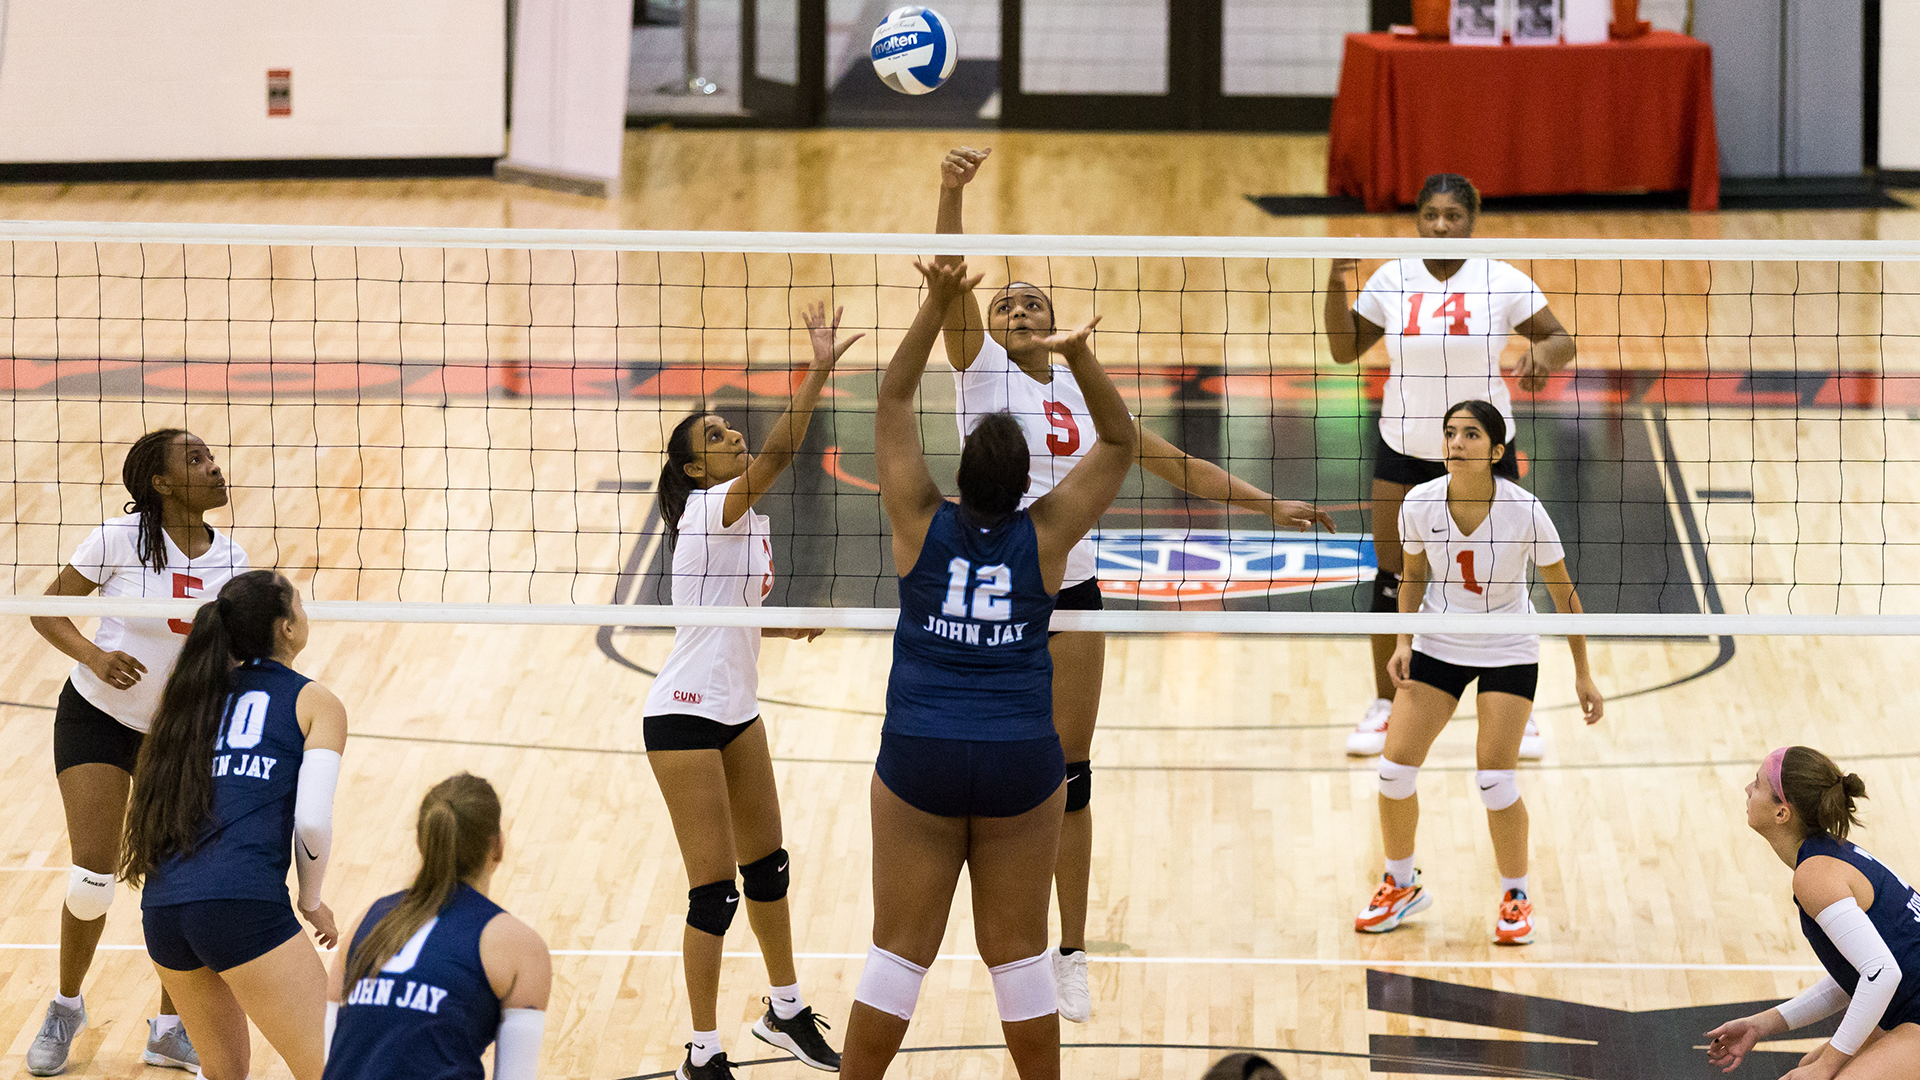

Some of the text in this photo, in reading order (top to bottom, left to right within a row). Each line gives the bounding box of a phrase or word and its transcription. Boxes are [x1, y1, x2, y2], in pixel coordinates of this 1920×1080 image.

[874, 33, 918, 56] molten
[1403, 292, 1472, 337] 14
[1042, 399, 1080, 456] 9
[941, 556, 1012, 621] 12
[1456, 550, 1483, 595] 1
[923, 615, 1029, 647] JOHN JAY
[673, 690, 704, 704] CUNY
[233, 753, 278, 781] JAY
[395, 980, 448, 1014] JAY
